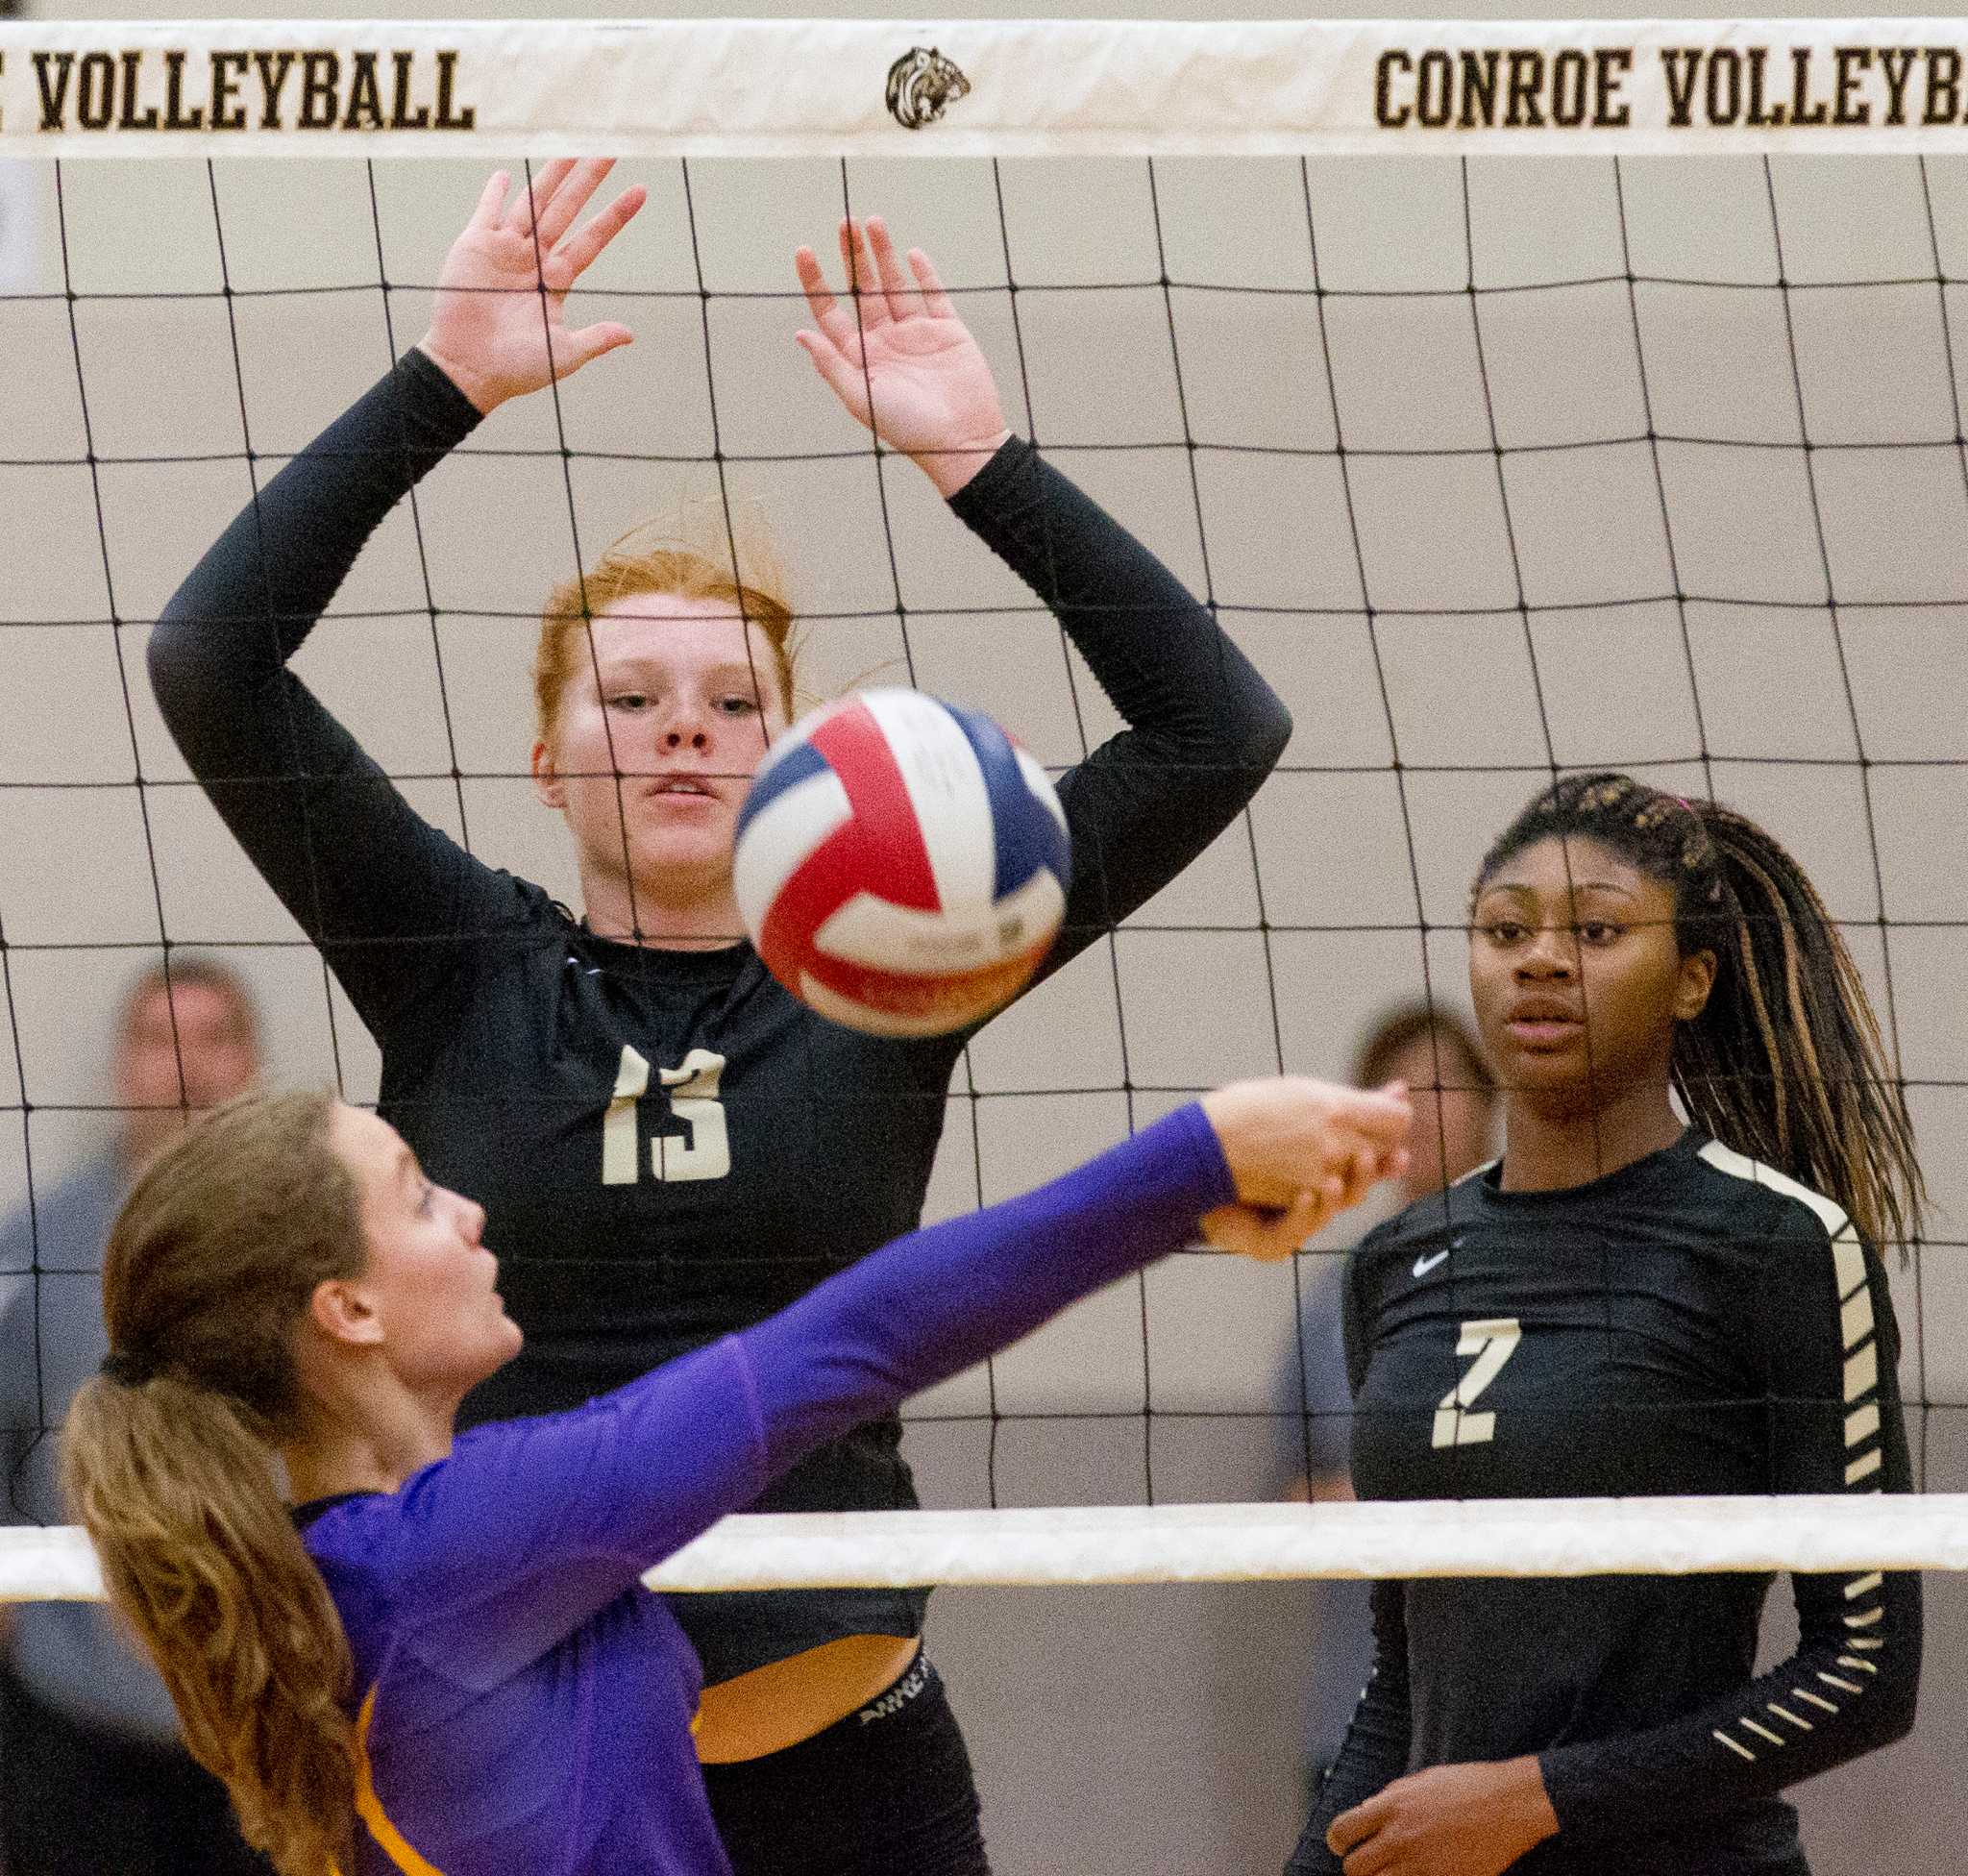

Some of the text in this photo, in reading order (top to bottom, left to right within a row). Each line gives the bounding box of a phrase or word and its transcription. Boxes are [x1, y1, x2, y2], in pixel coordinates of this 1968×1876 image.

[32, 51, 476, 131] VOLLEYBALL
[1375, 46, 1968, 128] CONROE VOLLEYB
[603, 1045, 730, 1185] 13
[1432, 1318, 1522, 1449] 2
